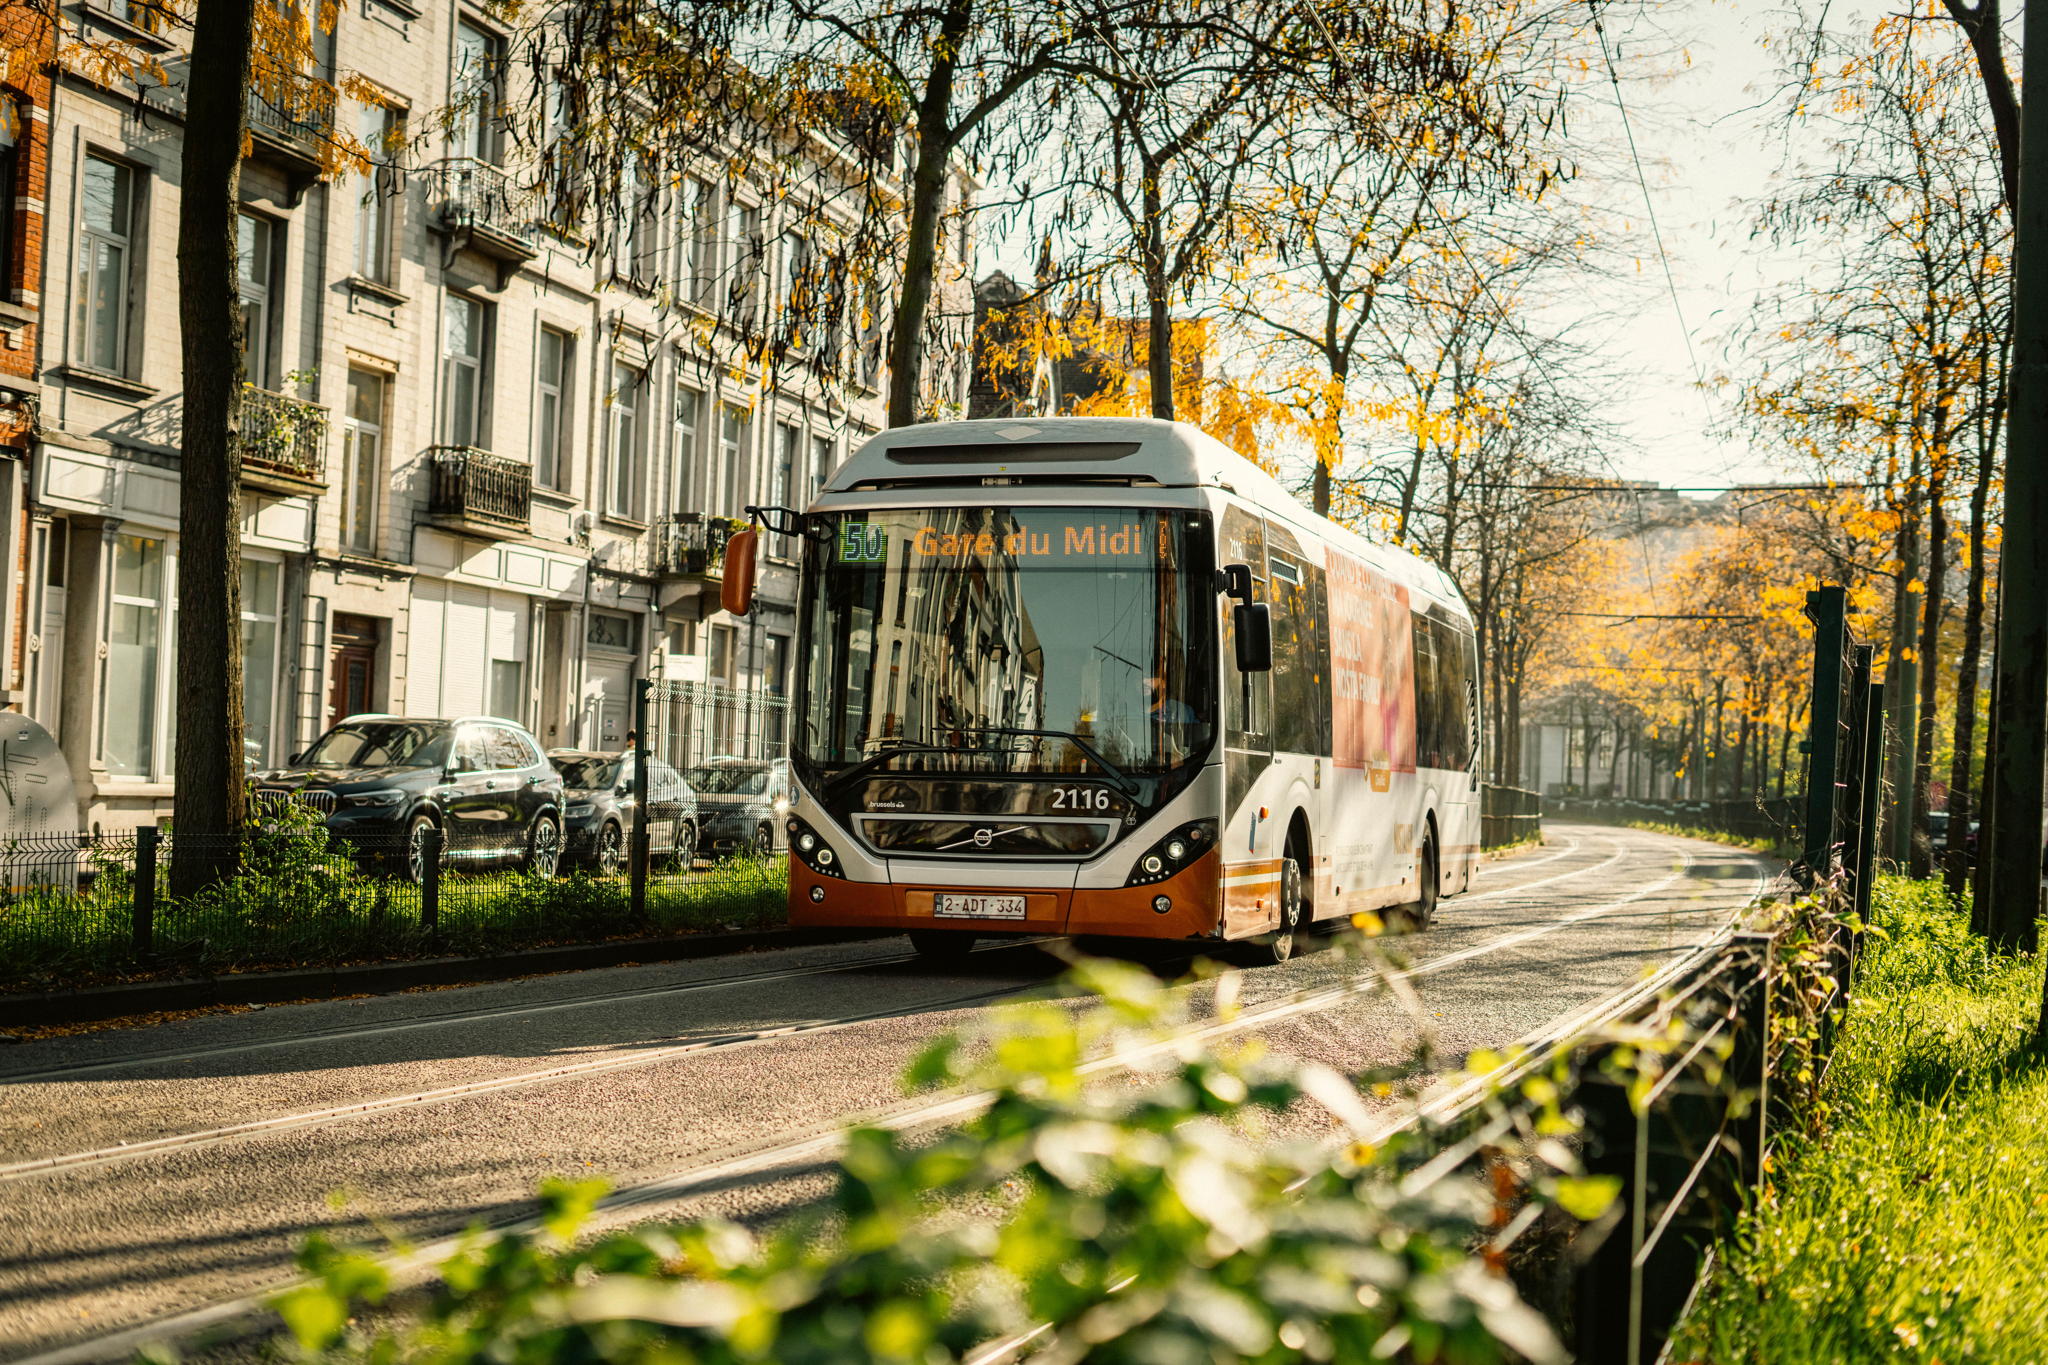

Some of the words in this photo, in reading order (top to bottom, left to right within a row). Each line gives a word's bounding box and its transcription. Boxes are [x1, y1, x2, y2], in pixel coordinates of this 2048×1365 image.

[845, 522, 883, 561] 50
[913, 526, 993, 556] Gare
[1008, 525, 1050, 555] du
[1064, 525, 1142, 555] Midi
[1230, 538, 1243, 560] 2116
[1052, 788, 1109, 809] 2116
